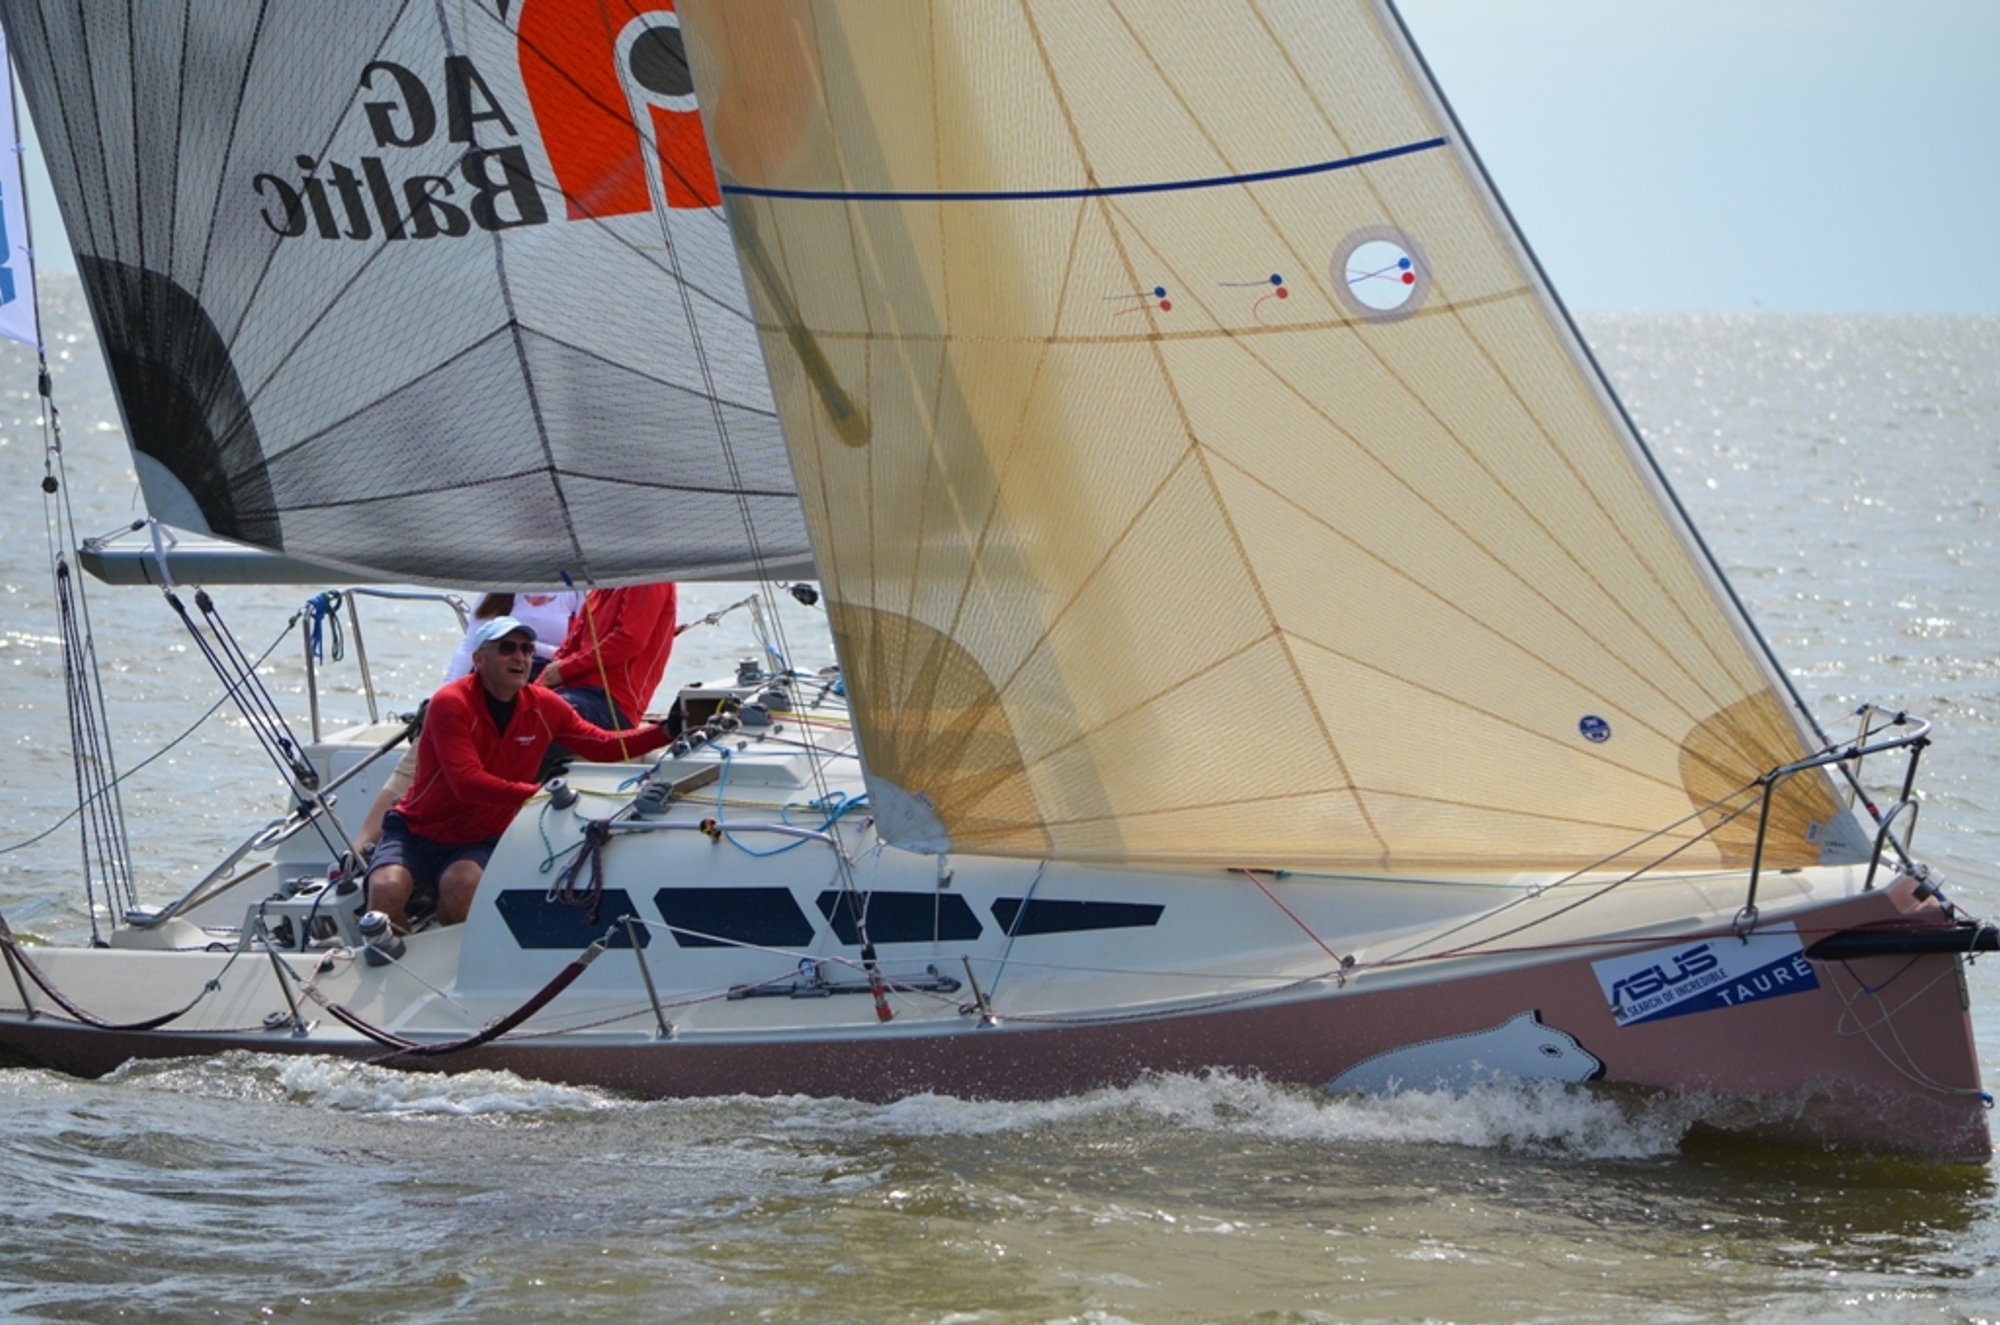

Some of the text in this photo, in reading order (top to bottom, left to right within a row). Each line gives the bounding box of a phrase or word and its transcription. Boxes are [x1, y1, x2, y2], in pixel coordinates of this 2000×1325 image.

[1612, 943, 1718, 1006] ASUS
[1627, 996, 1663, 1017] SEARCH
[1662, 989, 1675, 1002] OF
[1674, 967, 1729, 998] INCREDIBLE
